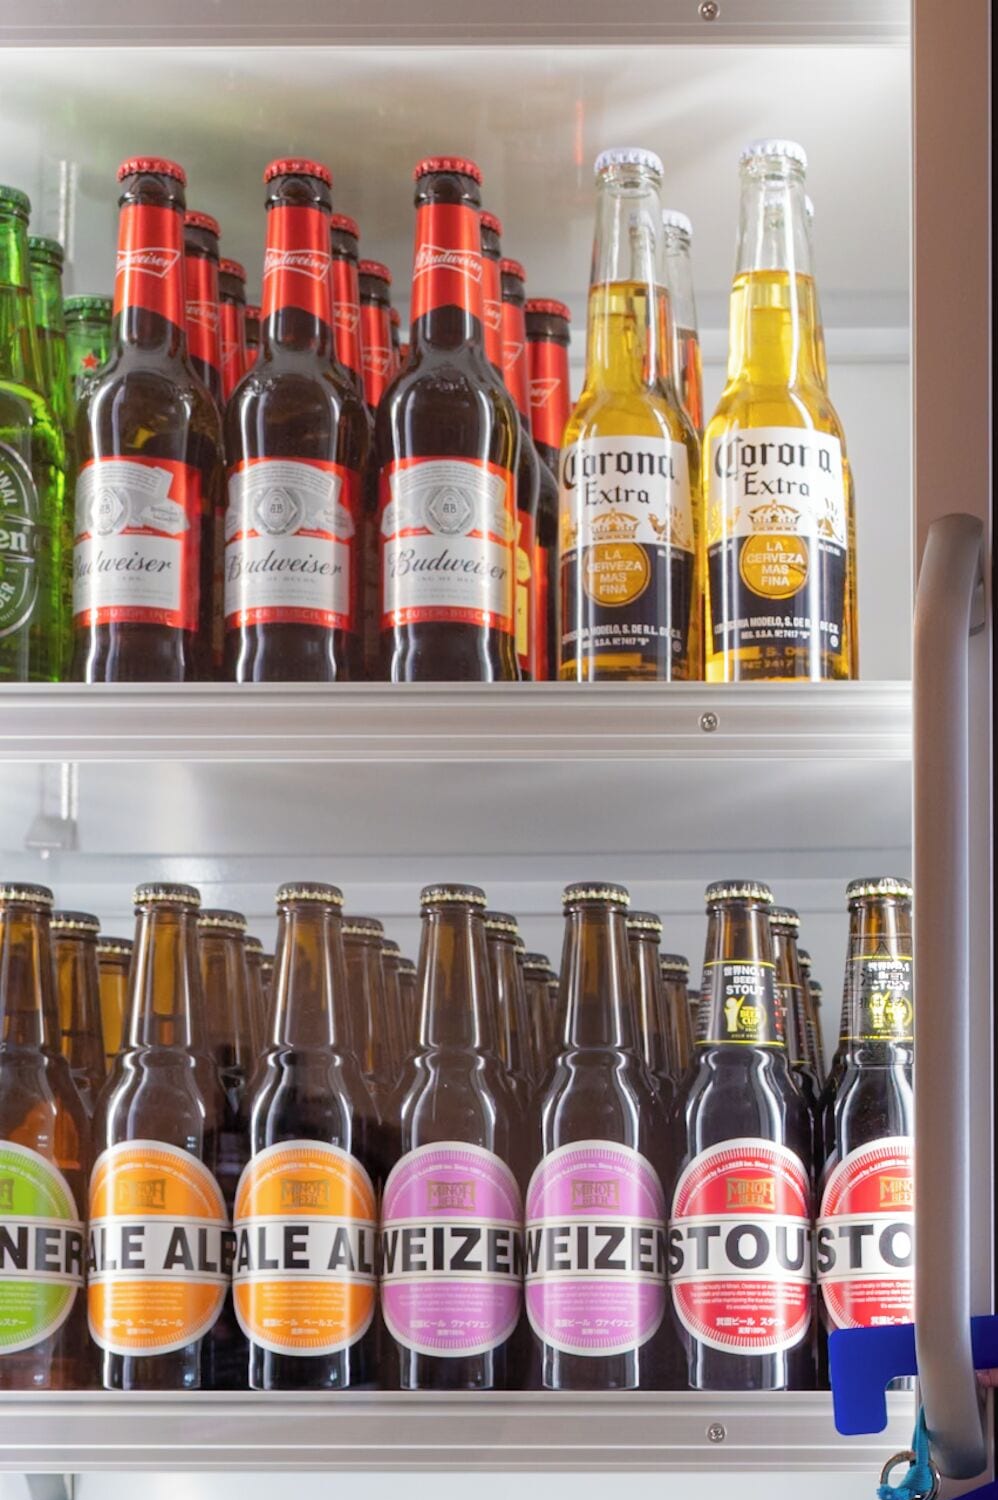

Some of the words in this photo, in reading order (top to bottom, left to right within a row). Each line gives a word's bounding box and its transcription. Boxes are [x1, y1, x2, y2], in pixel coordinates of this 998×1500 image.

[563, 448, 675, 490] Corona
[585, 482, 650, 506] Extra
[744, 472, 810, 496] Extra
[604, 551, 622, 560] LA
[748, 553, 804, 564] CERVEZA
[766, 542, 783, 552] LA
[226, 550, 342, 582] Budweiser
[389, 549, 507, 580] Budweiser
[587, 561, 642, 572] CERVEZA
[761, 565, 789, 575] MAS
[600, 573, 627, 583] MAS
[600, 584, 628, 594] FINA
[761, 576, 790, 586] FINA
[726, 985, 765, 996] STOUT
[0, 1226, 83, 1277] NER
[86, 1226, 145, 1272] ALE
[327, 1227, 377, 1275] AL
[669, 1224, 810, 1275] STOU
[817, 1223, 912, 1274] STO
